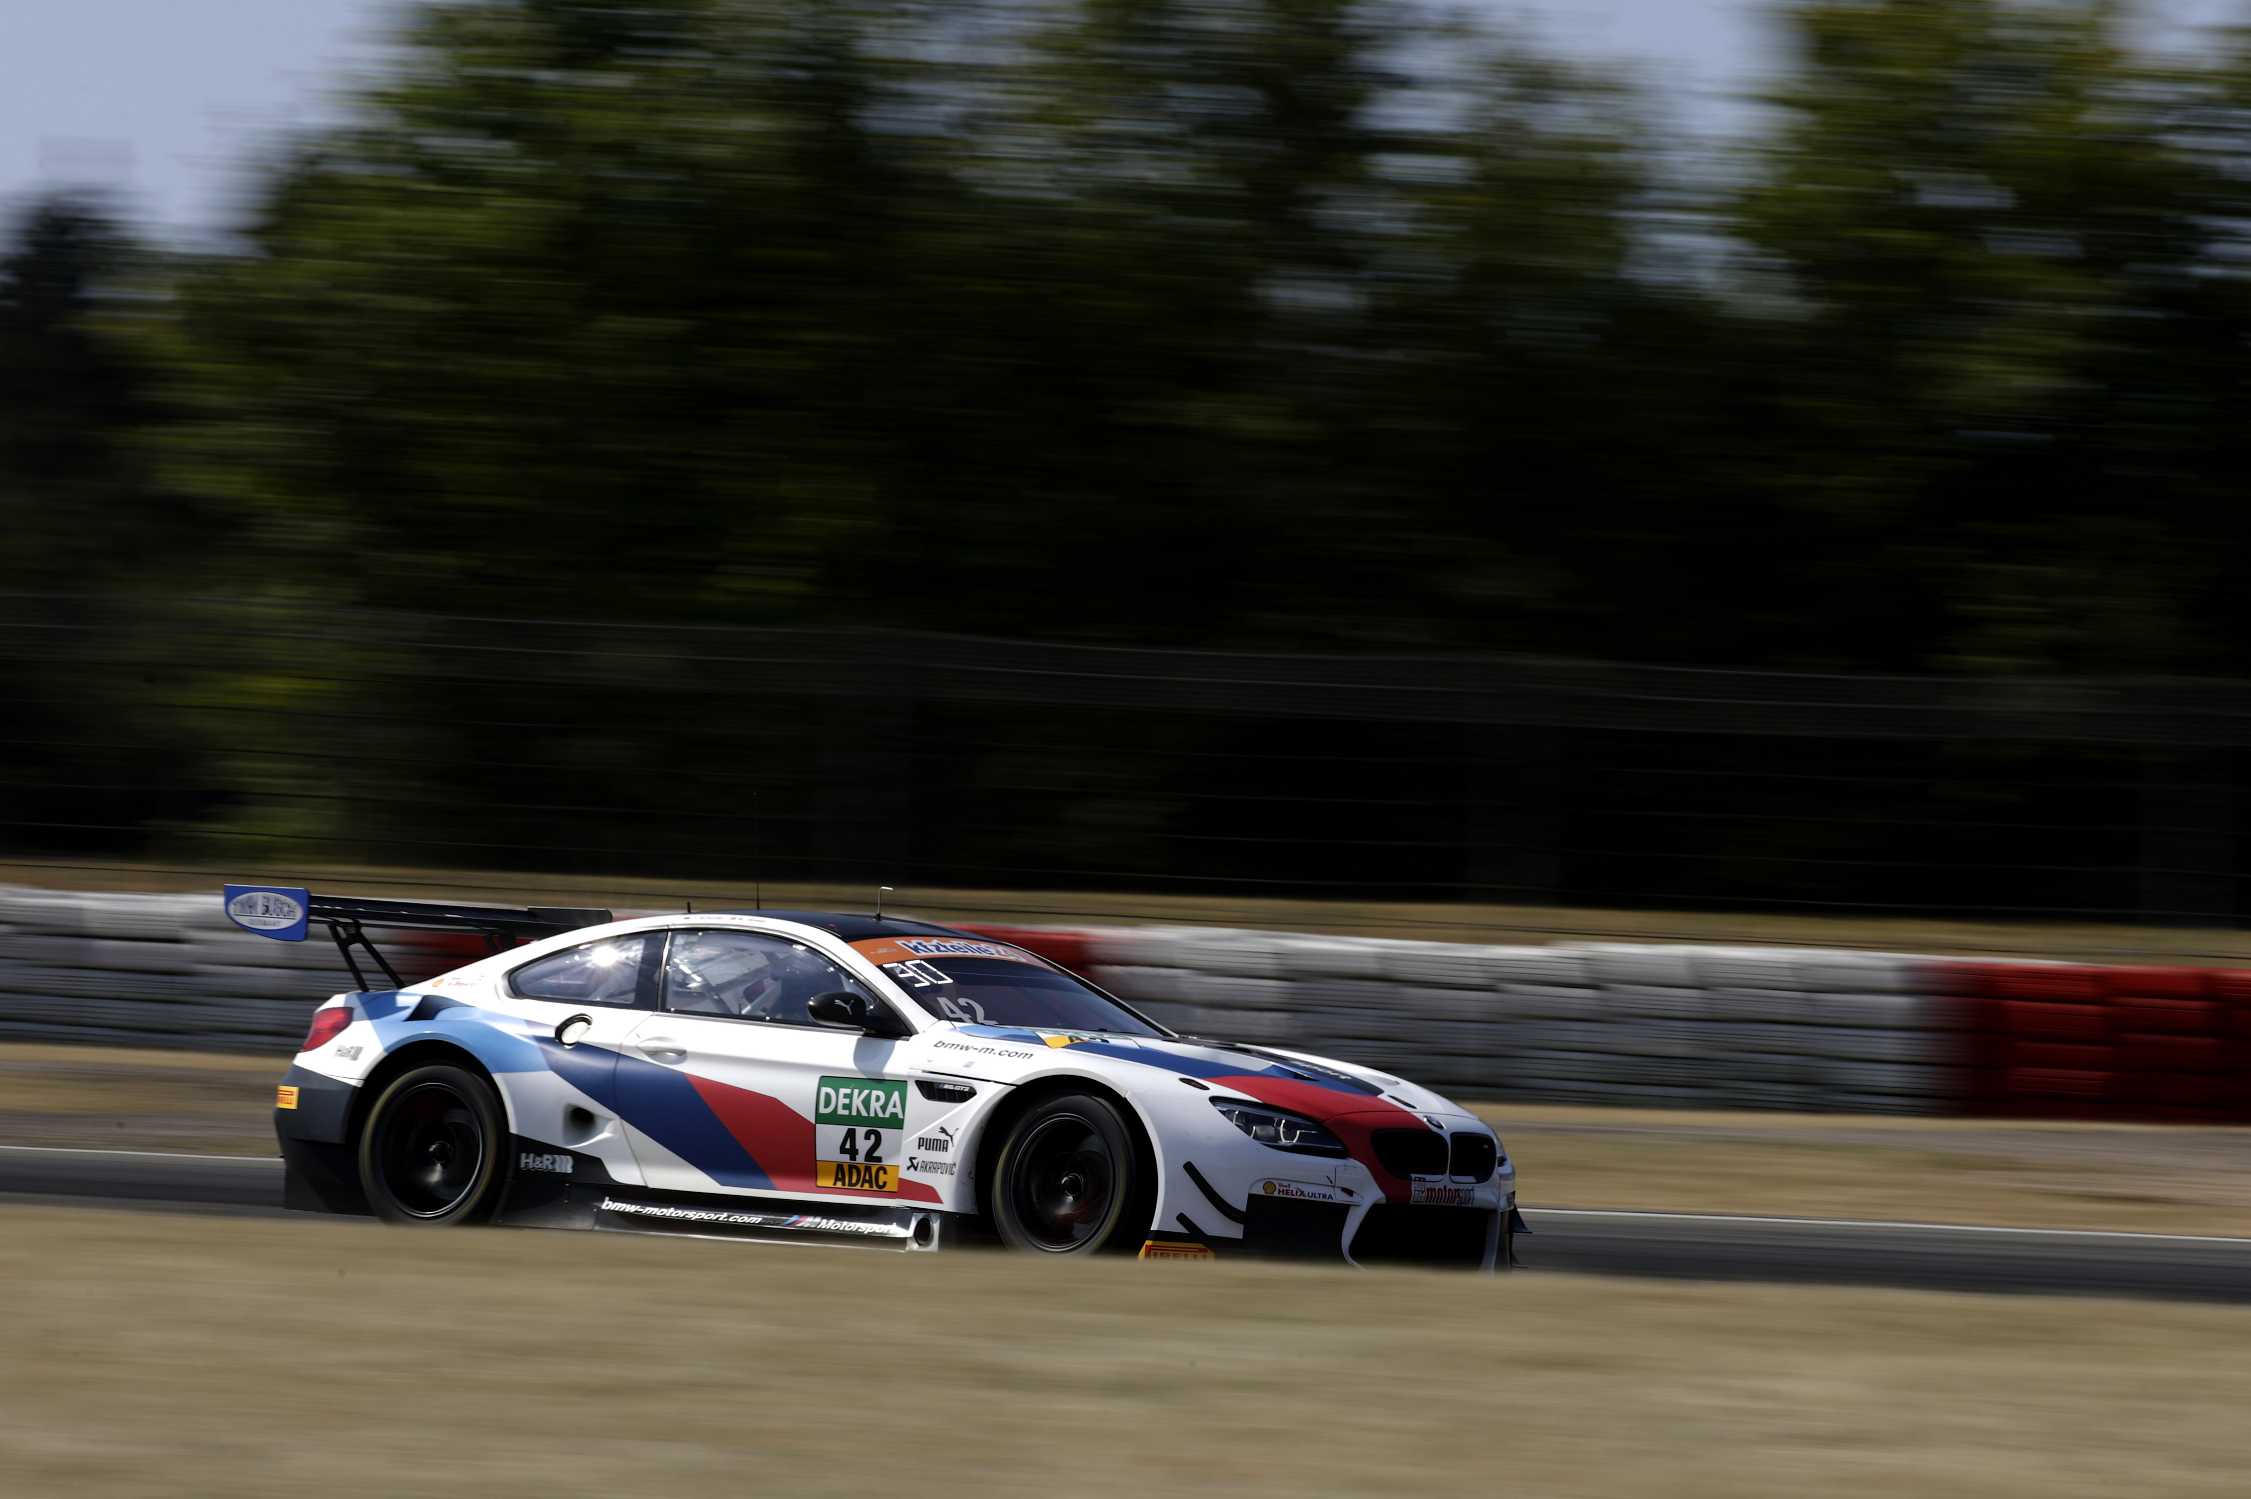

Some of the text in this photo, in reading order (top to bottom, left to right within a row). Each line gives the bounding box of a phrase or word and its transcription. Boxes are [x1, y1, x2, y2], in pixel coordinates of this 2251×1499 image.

[883, 960, 954, 987] 30
[937, 997, 999, 1025] 42
[934, 1040, 1034, 1060] bmw-m.com
[819, 1087, 904, 1119] DEKRA
[839, 1127, 883, 1163] 42
[917, 1137, 949, 1152] PUMA
[520, 1153, 554, 1170] H&R
[832, 1163, 888, 1190] ADAC
[1278, 1187, 1334, 1200] HELIX ULTRA
[601, 1197, 763, 1224] bmw-motorsport.com
[817, 1218, 901, 1237] Motorsport
